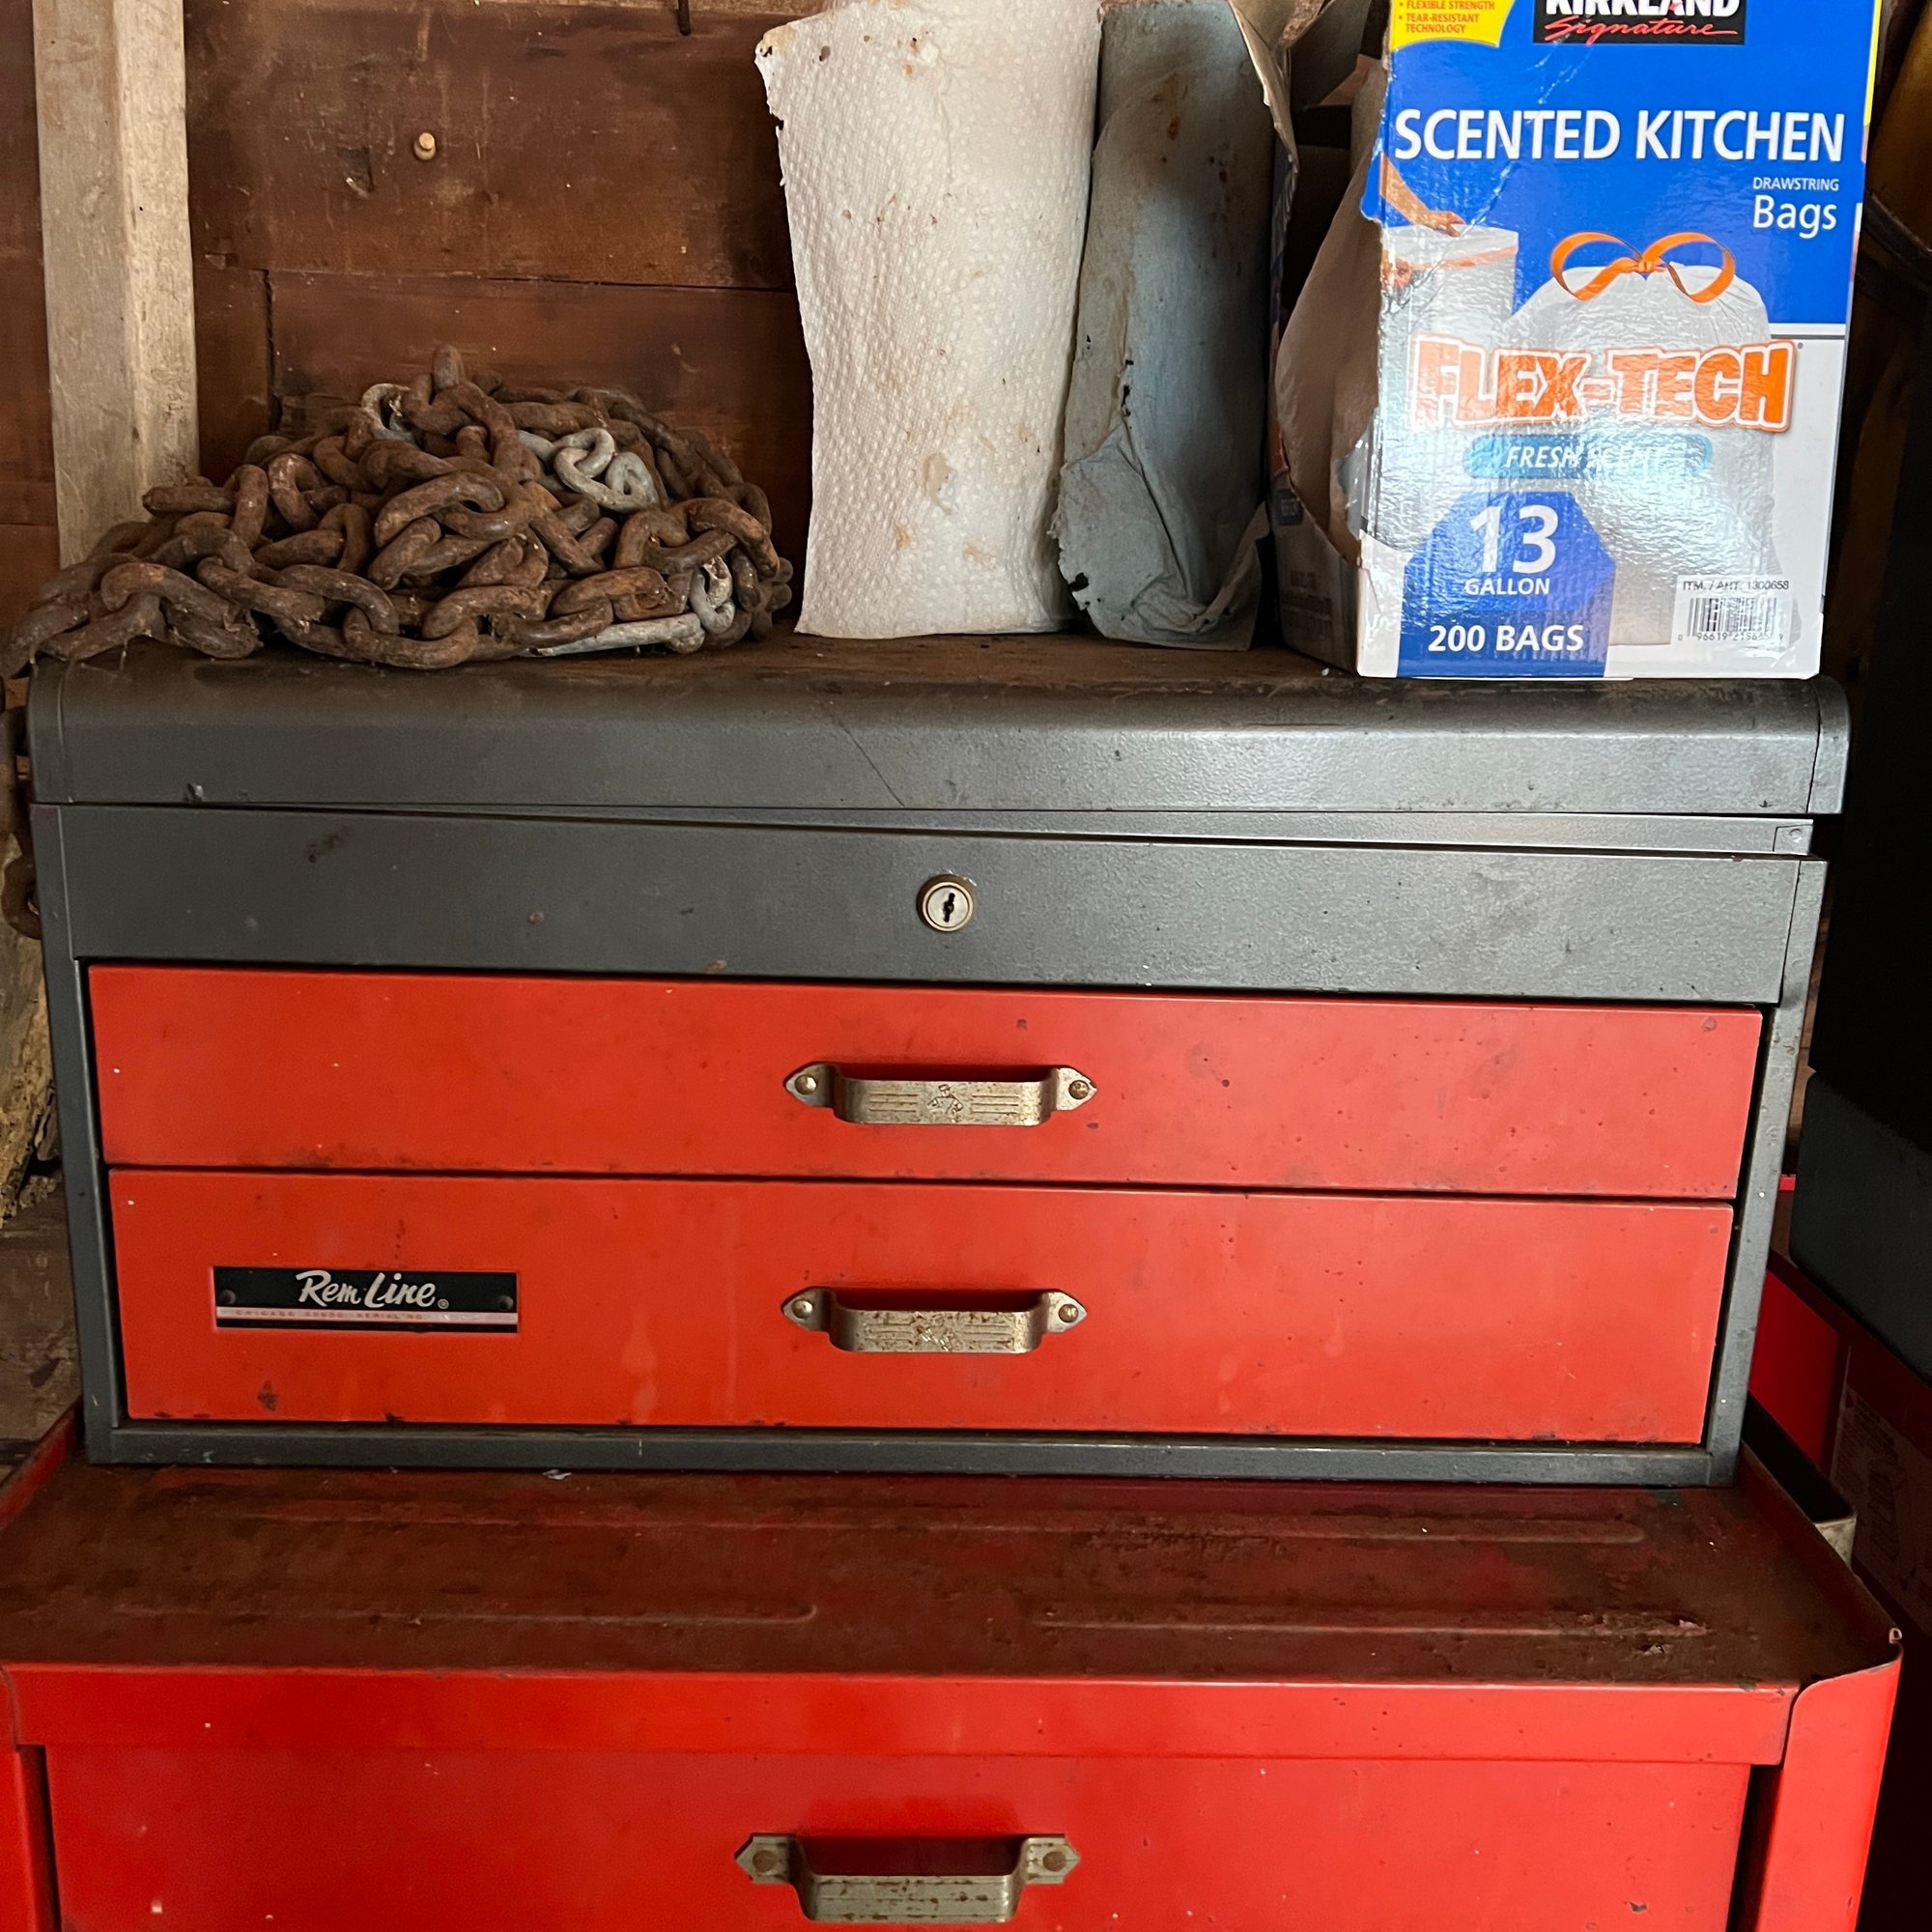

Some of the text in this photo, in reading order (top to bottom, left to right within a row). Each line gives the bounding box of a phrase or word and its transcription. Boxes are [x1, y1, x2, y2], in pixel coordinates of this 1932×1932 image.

[1406, 1, 1494, 10] FLEXIBLE STRENGTH
[1406, 14, 1479, 22] TEAR-RESISTANT
[1406, 24, 1465, 33] TECHNOLOGY
[1545, 14, 1738, 45] Signature
[1394, 109, 1845, 162] SCENTED KITCHEN
[1753, 177, 1839, 191] DRAWSTRING
[1753, 194, 1837, 240] Bags
[1411, 334, 1795, 431] FLEX-TECH
[1503, 445, 1580, 469] FRESH
[1469, 504, 1558, 574] 13
[1463, 579, 1550, 595] GALLON
[1747, 580, 1789, 590] 1300658
[1428, 625, 1584, 652] 200 BAGS
[1696, 632, 1728, 641] 96619
[295, 1269, 361, 1307] Rem
